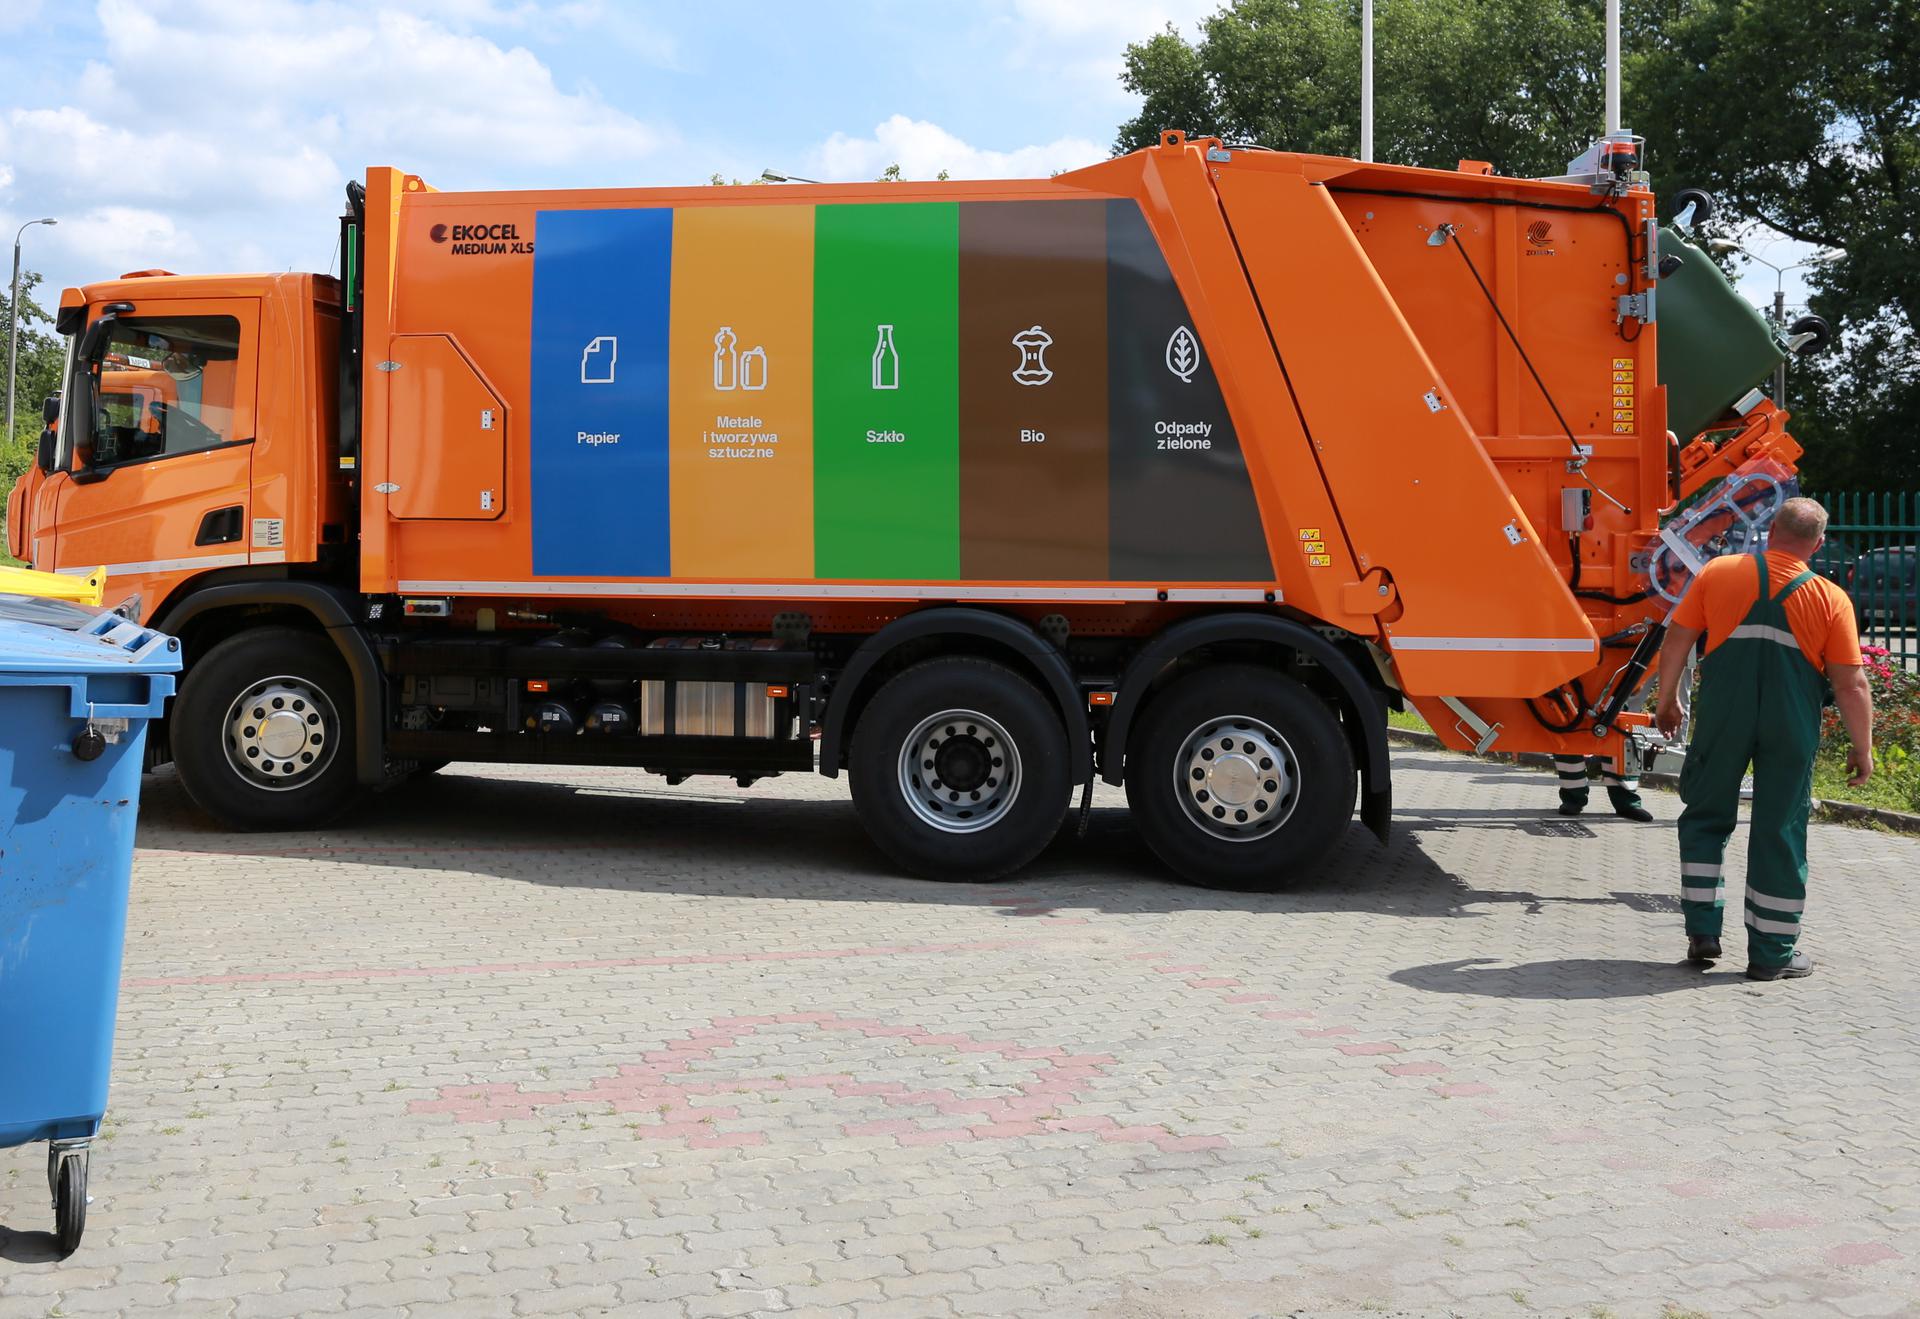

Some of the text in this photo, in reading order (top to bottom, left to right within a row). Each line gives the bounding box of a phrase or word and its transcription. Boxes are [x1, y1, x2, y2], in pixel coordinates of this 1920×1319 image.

[452, 224, 520, 241] EKOCEL
[451, 242, 535, 255] MEDIUM XLS
[716, 416, 763, 428] Metale
[1154, 421, 1212, 436] Odpady
[577, 431, 620, 446] Papier
[710, 431, 778, 446] tworzywa
[866, 430, 905, 443] Szkło
[1020, 430, 1045, 443] Bio
[1157, 437, 1211, 450] zielone
[708, 447, 774, 458] sztuczne
